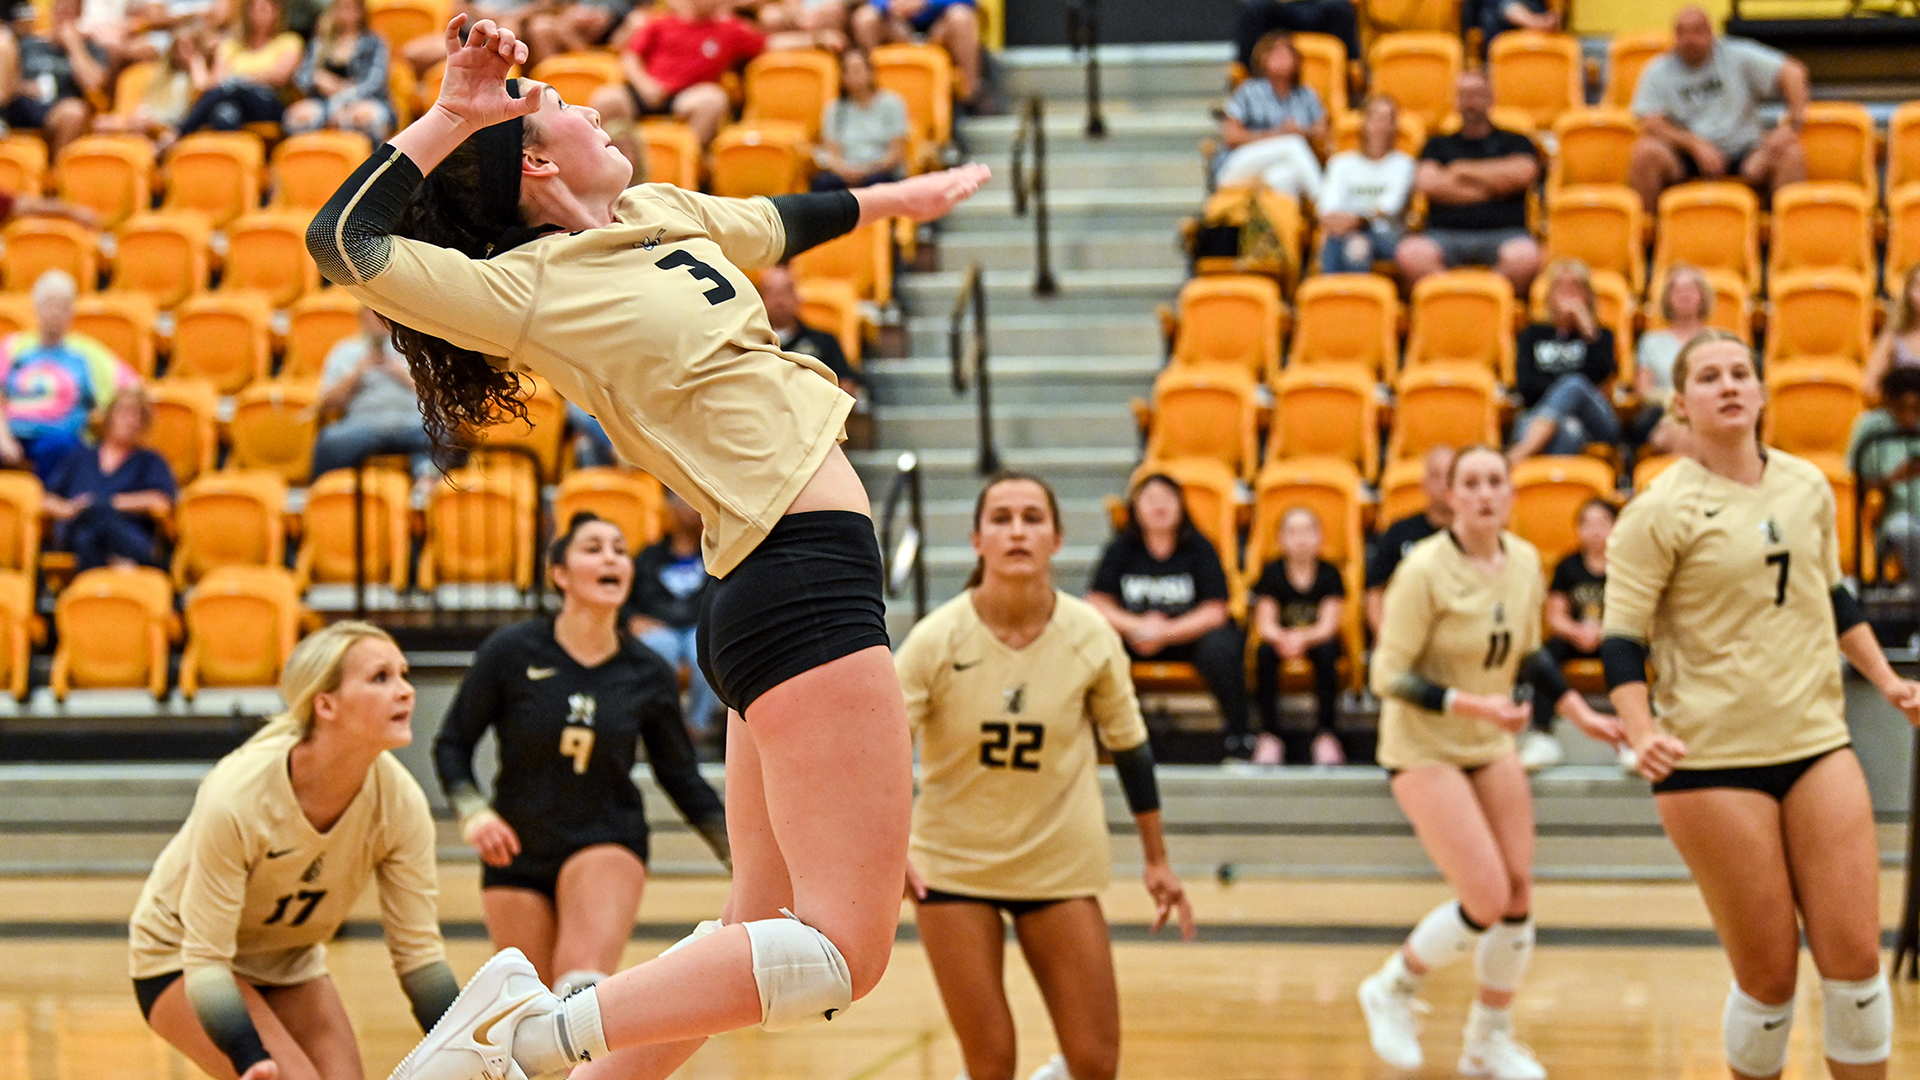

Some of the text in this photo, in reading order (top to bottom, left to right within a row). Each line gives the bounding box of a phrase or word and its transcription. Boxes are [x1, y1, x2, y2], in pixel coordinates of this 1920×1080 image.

[654, 249, 736, 306] 3
[1766, 552, 1790, 605] 7
[1485, 632, 1512, 669] 11
[560, 728, 595, 774] 9
[980, 723, 1044, 770] 22
[264, 890, 327, 926] 17
